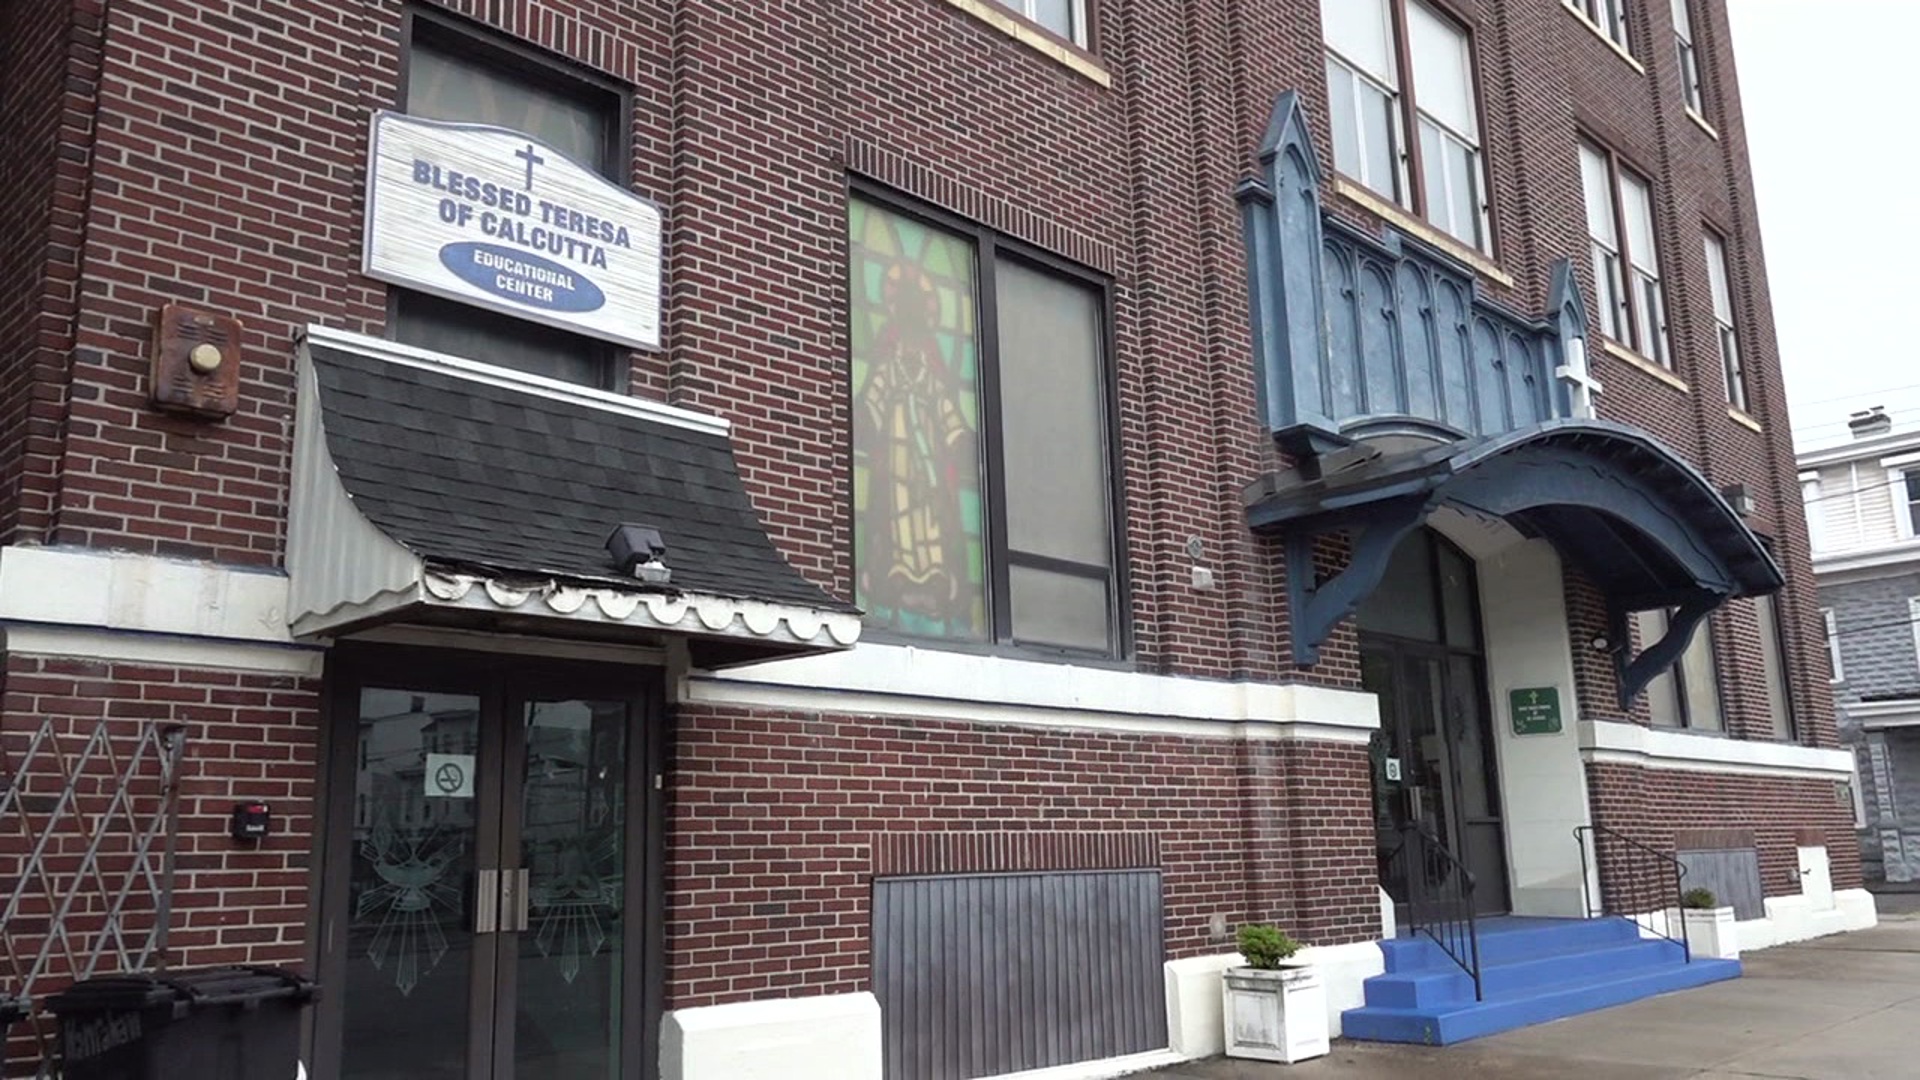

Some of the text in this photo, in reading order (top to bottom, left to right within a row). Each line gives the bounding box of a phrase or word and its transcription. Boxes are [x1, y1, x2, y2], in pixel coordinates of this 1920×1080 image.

[413, 159, 631, 248] BLESSED TERESA
[439, 199, 607, 269] OF CALCUTTA
[474, 250, 575, 290] EDUCATIONAL
[496, 274, 553, 303] CENTER
